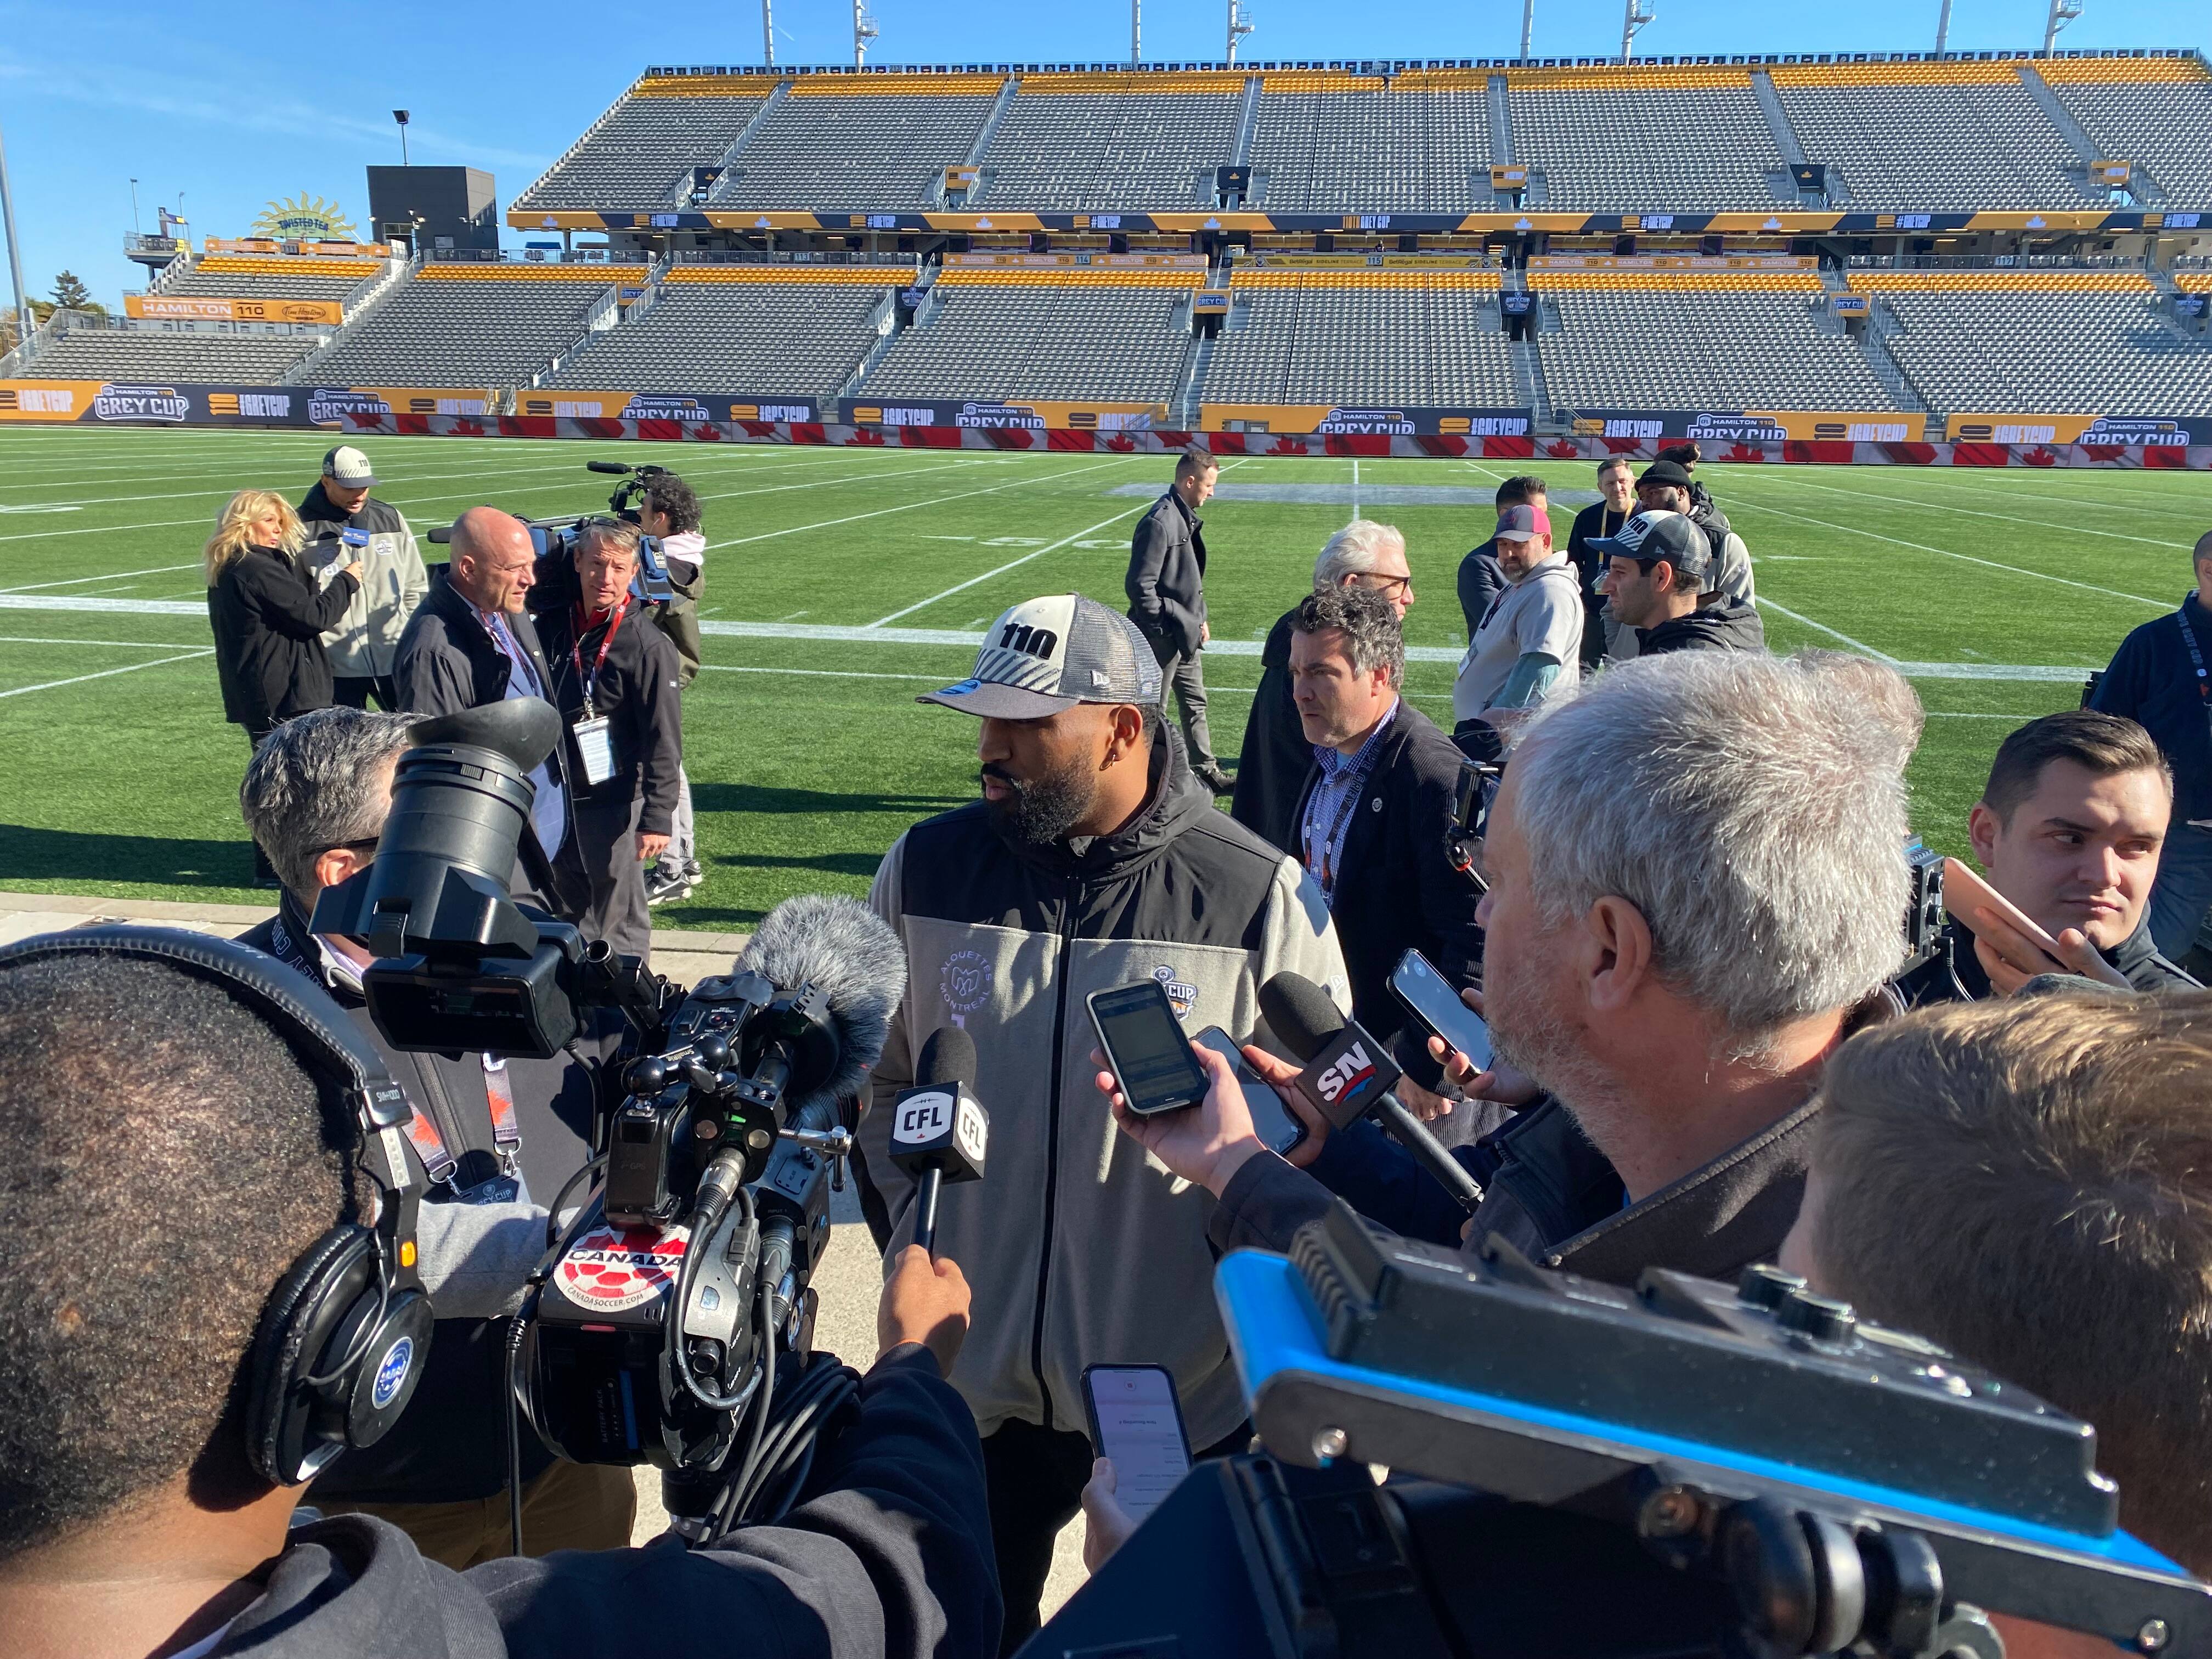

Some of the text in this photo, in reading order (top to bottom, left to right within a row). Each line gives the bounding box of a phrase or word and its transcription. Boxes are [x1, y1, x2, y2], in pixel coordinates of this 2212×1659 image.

[278, 217, 329, 232] TWISTED TEA
[1378, 216, 1390, 228] CUP
[1997, 257, 2012, 265] 117
[143, 303, 263, 315] HAMILTON 110
[285, 307, 324, 315] Tim Hortons
[100, 397, 187, 416] GREY CUP
[239, 394, 290, 416] #GREYCUP
[1000, 623, 1058, 659] 110
[2190, 649, 2203, 664] CUP
[1344, 772, 1365, 807] GREY
[1333, 809, 1348, 834] CUP
[941, 951, 992, 981] ALOUETTES
[939, 983, 990, 1012] MONTREAL
[1168, 985, 1194, 1000] CUP
[666, 1048, 695, 1062] SmallRig
[1317, 1041, 1372, 1102] SN
[904, 1107, 943, 1131] CFL
[963, 1112, 980, 1150] CFL
[495, 1189, 511, 1201] CUP
[568, 1250, 682, 1267] CANADA
[567, 1286, 644, 1307] CANADASOCCER.COM
[685, 1376, 712, 1405] PROFESSIONAL
[599, 1410, 608, 1443] BATTERY
